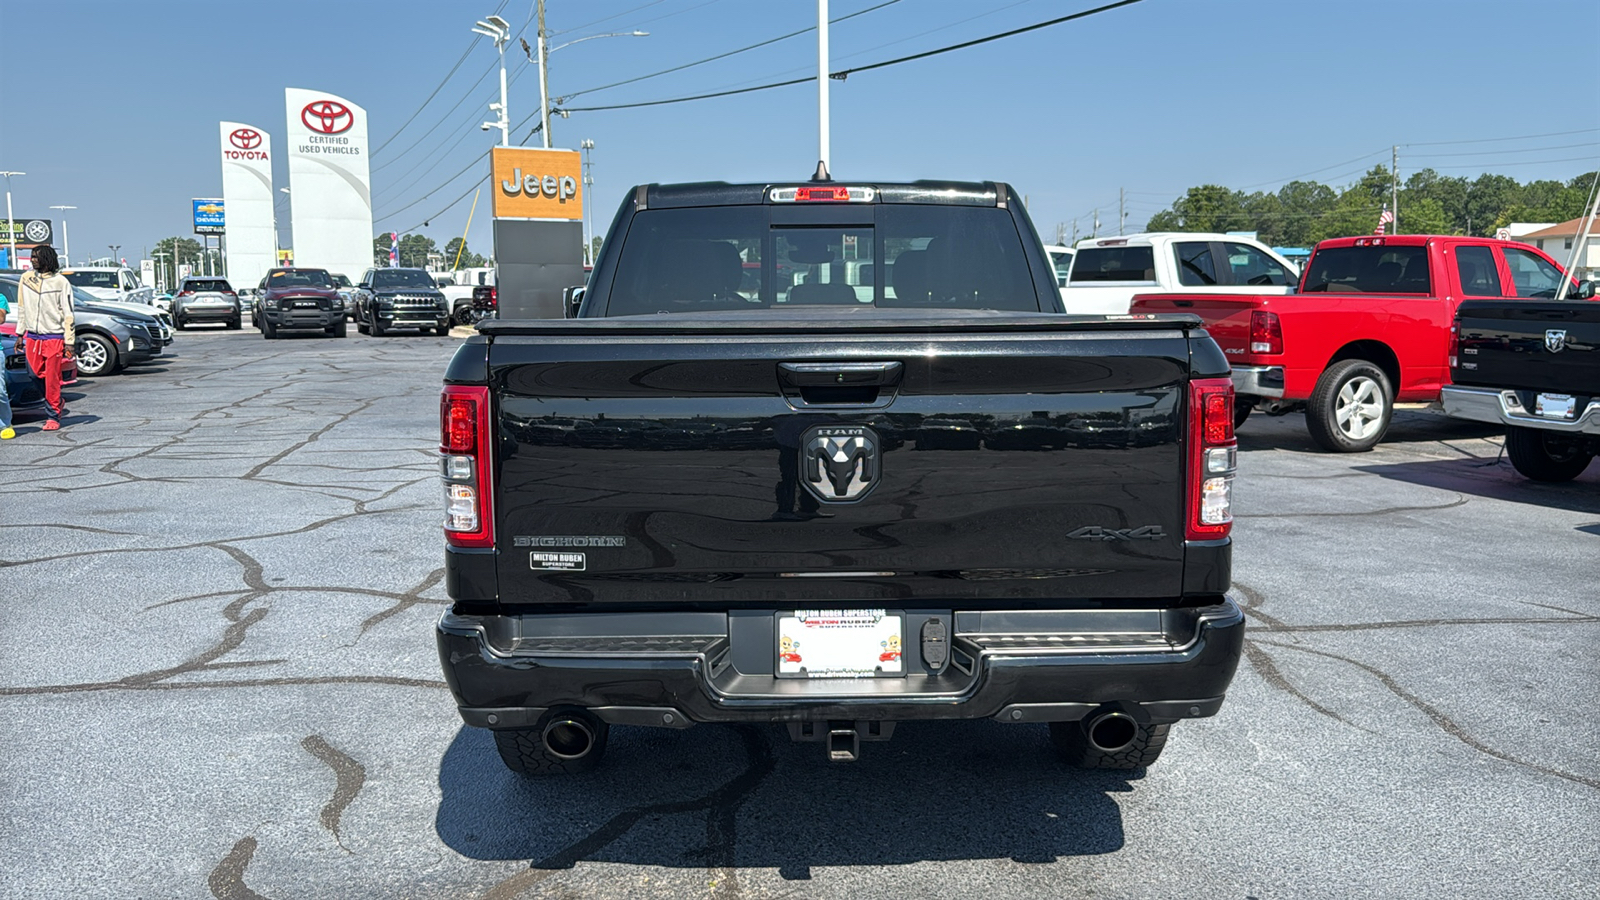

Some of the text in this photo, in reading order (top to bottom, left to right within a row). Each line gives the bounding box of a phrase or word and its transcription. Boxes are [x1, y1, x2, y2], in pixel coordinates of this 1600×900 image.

[309, 136, 349, 145] CERTIFIED
[299, 145, 360, 155] USED VEHICLES
[224, 150, 269, 161] TOYOTA
[502, 168, 577, 202] Jeep
[513, 535, 626, 547] BIGHORN
[533, 553, 583, 562] MILTON RUBEN
[794, 609, 886, 618] MILTON RUBEN SUPERSTORE
